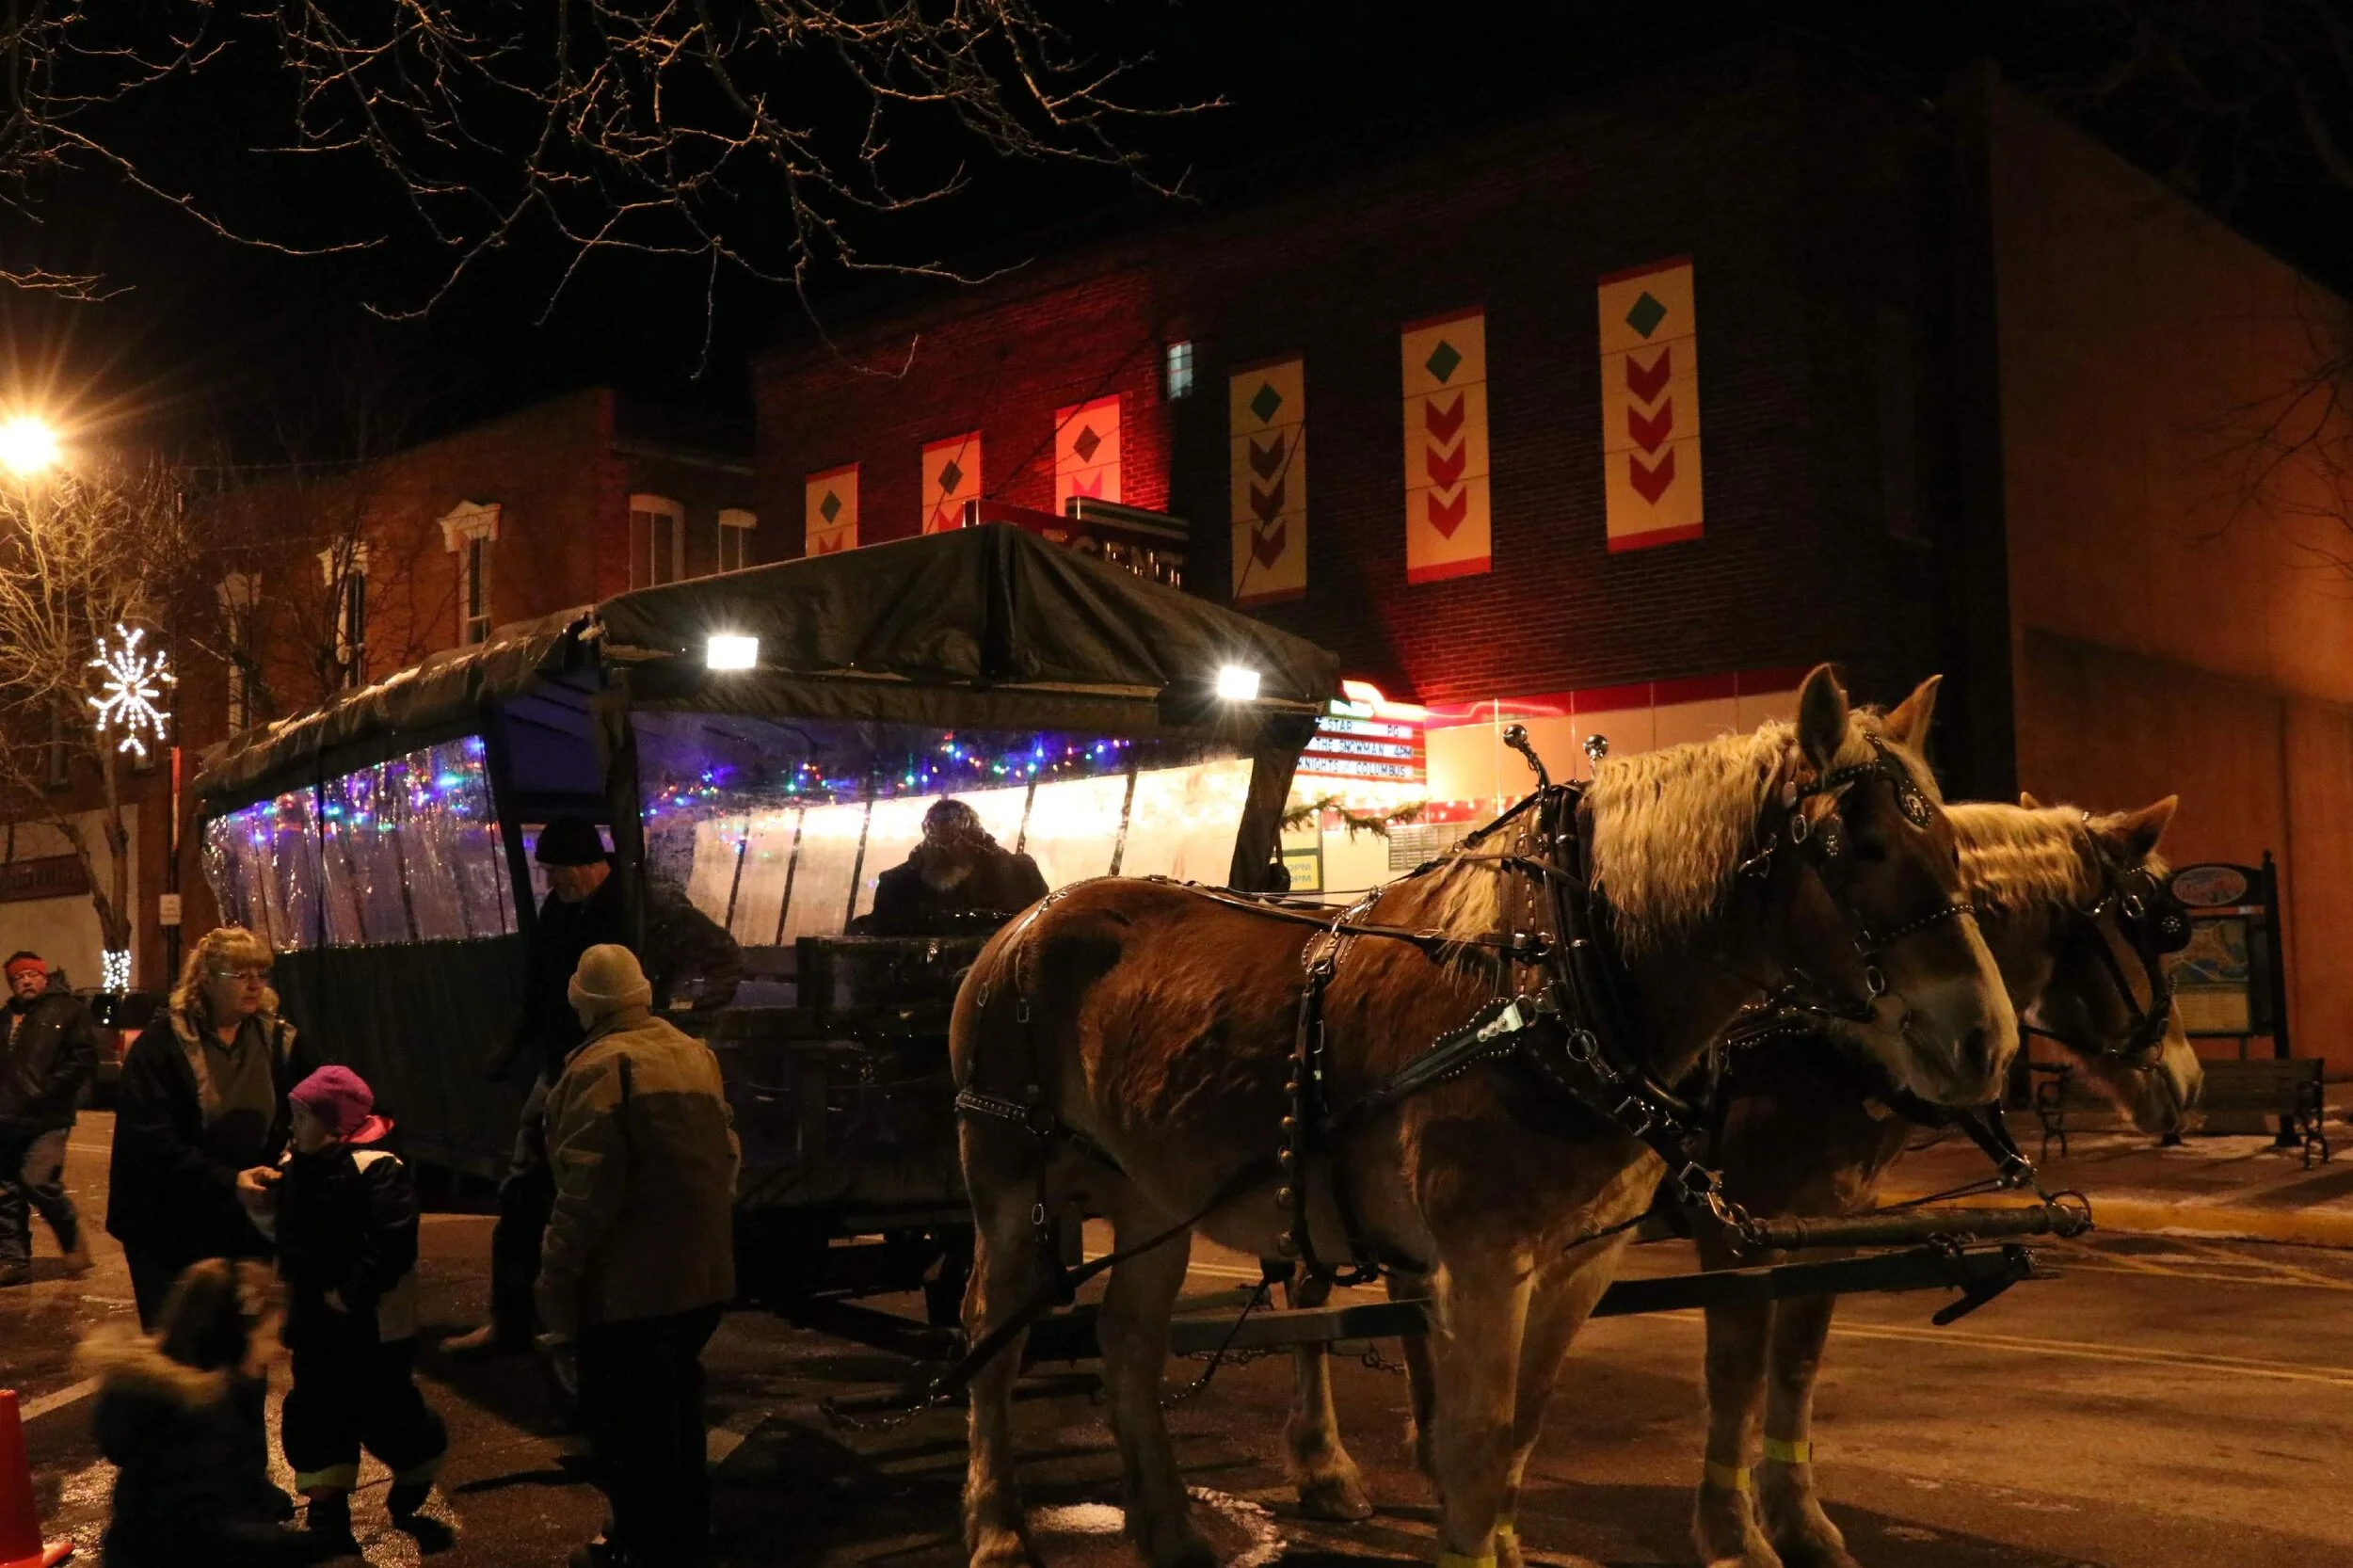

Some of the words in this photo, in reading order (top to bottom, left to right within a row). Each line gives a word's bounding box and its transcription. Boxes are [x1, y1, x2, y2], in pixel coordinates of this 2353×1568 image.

[1327, 718, 1353, 731] STAR
[1386, 725, 1400, 737] PG
[1316, 737, 1333, 751] THE
[1339, 740, 1385, 756] SNOWMAN
[1298, 757, 1338, 773] KNIGHTS
[1355, 761, 1406, 777] COLUMBUS
